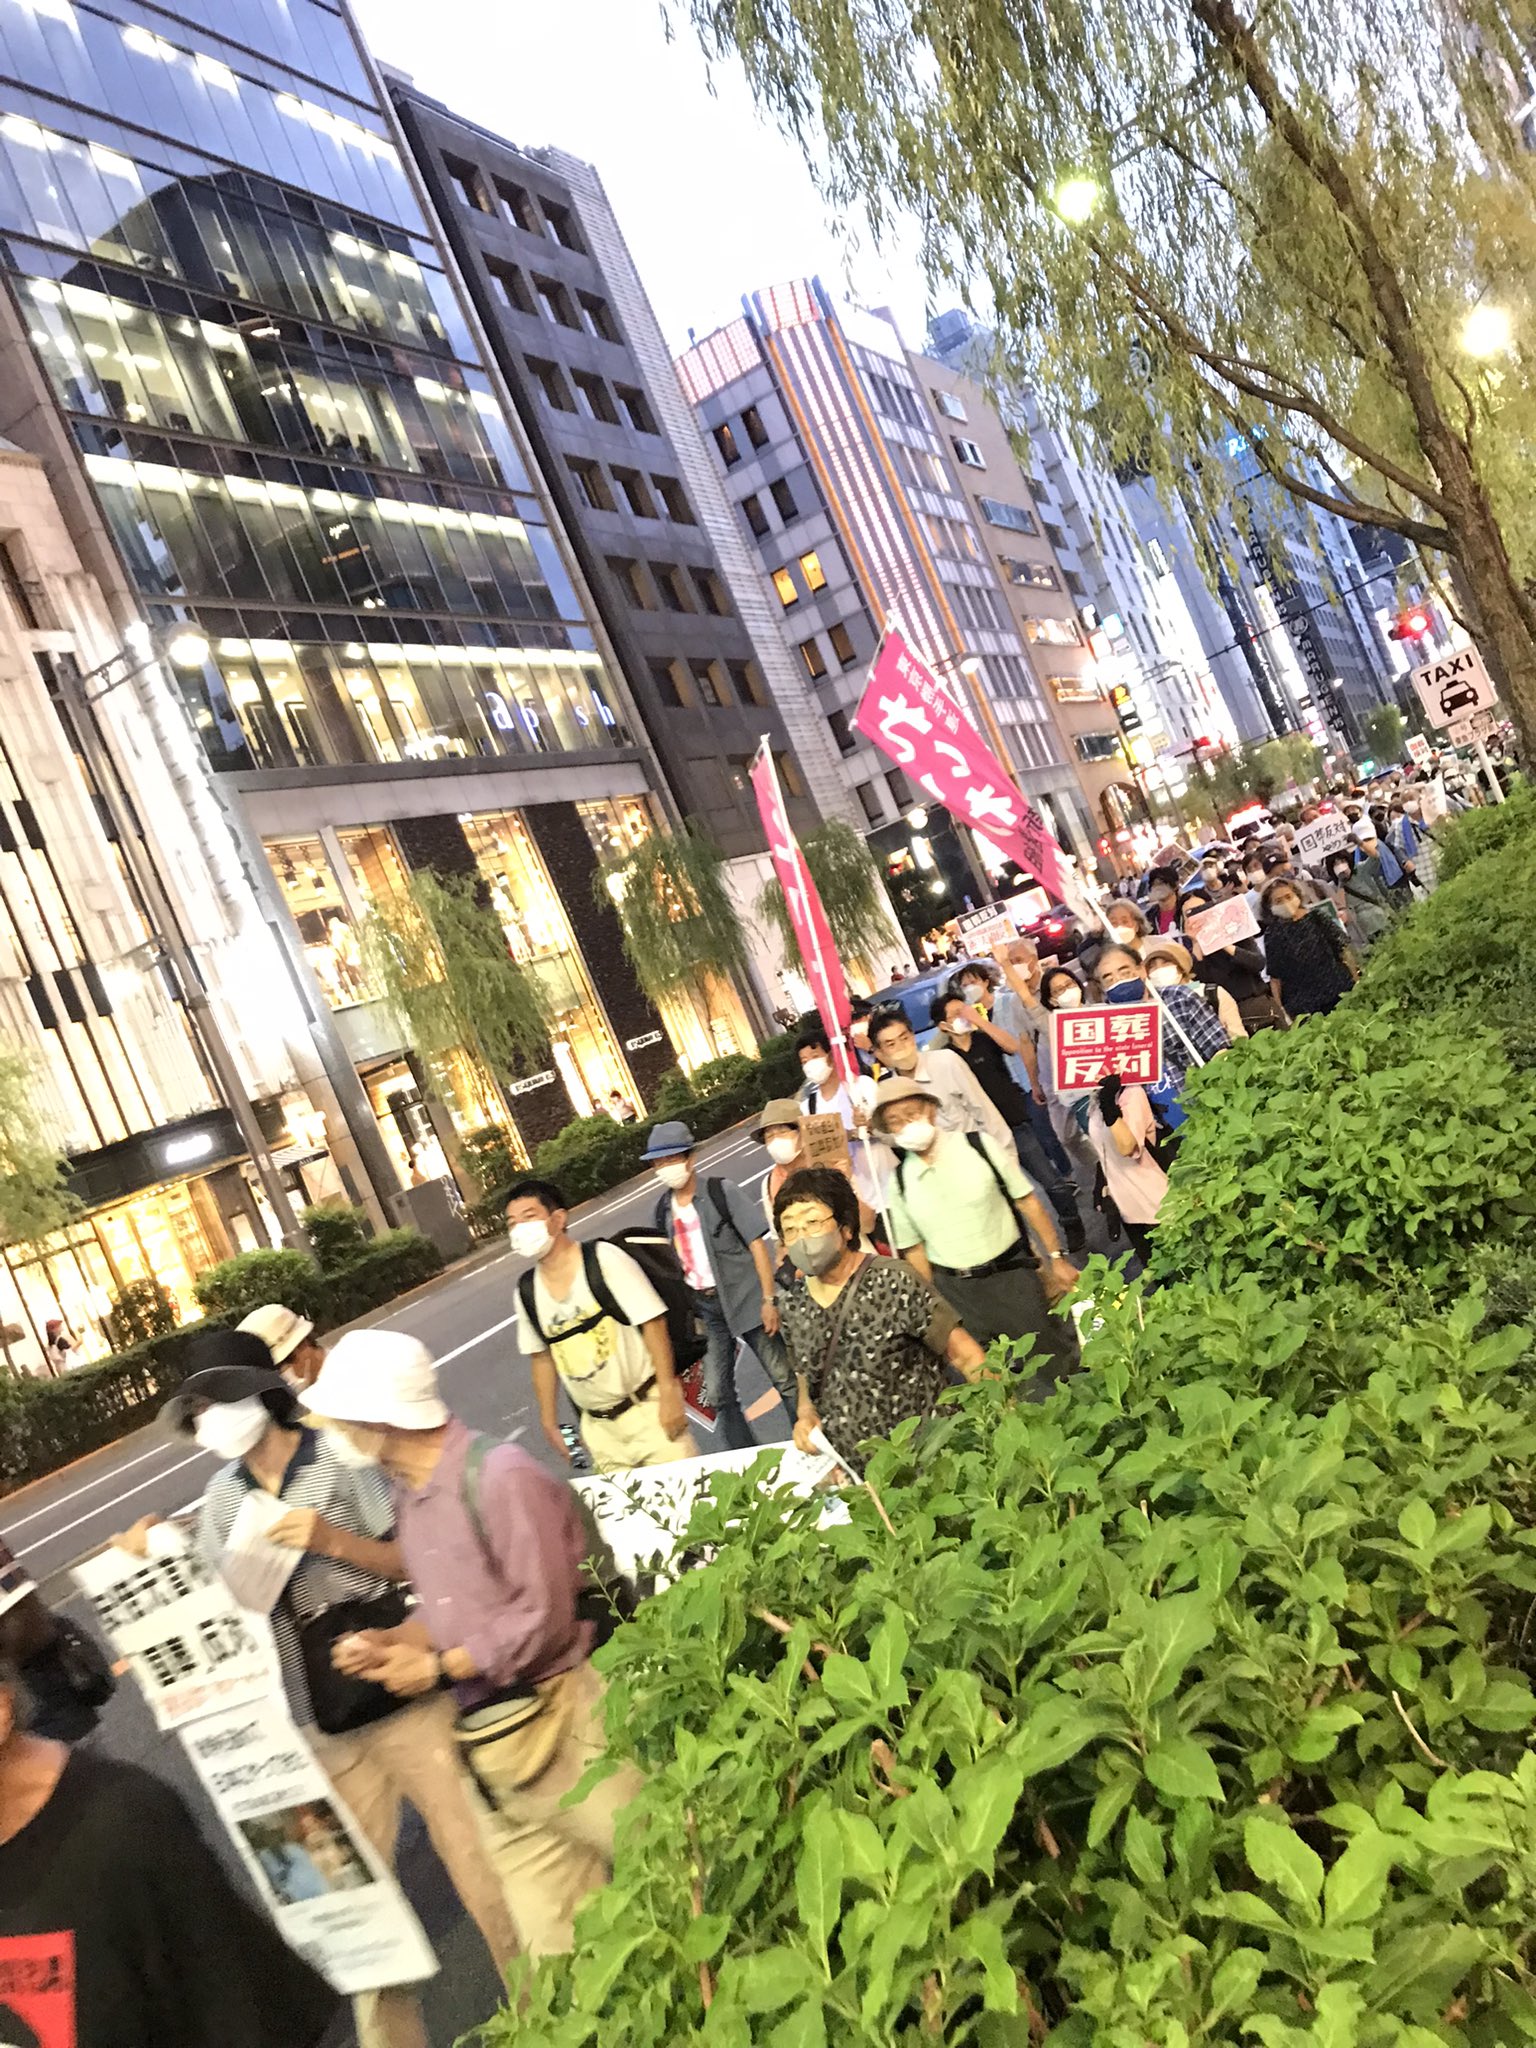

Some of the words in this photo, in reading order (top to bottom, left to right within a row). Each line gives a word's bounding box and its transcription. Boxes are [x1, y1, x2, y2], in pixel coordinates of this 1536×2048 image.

[1420, 654, 1474, 687] TAXI
[1063, 1013, 1151, 1047] 国葬
[1064, 1050, 1152, 1085] 反対
